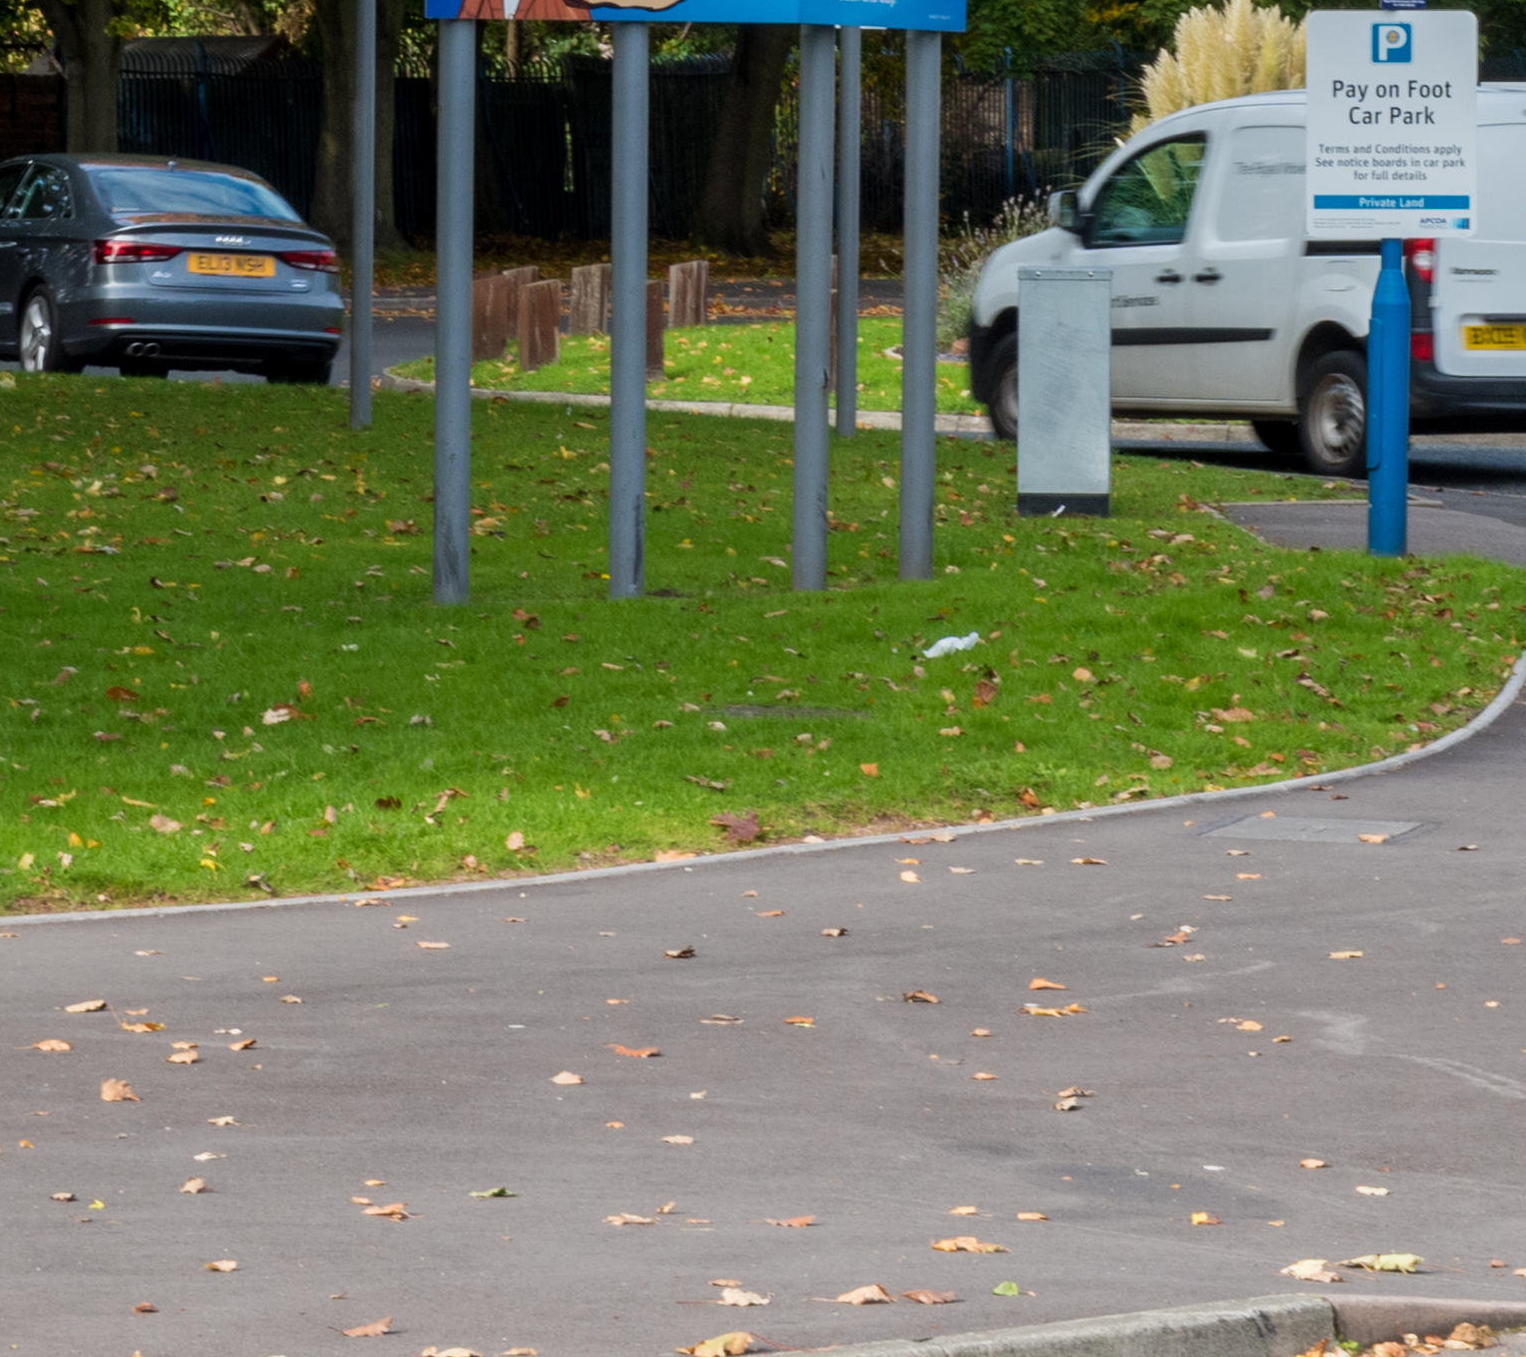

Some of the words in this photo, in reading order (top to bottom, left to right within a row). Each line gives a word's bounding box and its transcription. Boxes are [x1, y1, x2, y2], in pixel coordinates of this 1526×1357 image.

[1332, 79, 1369, 103] Pay
[1375, 84, 1400, 99] on
[1408, 79, 1452, 99] Foot
[1348, 105, 1382, 125] Car
[1389, 105, 1436, 125] Park
[1319, 143, 1350, 154] Terms
[1353, 143, 1372, 154] and
[1375, 143, 1431, 154] Conditions
[1433, 143, 1463, 156] apply
[1315, 157, 1334, 167] See
[1337, 157, 1368, 167] notice
[1372, 157, 1407, 167] boards
[1411, 157, 1421, 167] in
[1423, 159, 1439, 167] car
[1442, 157, 1466, 169] park
[1353, 170, 1368, 181] for
[1371, 170, 1389, 181] full
[1391, 170, 1428, 181] details
[1358, 196, 1397, 208] Private
[1399, 196, 1425, 208] Land
